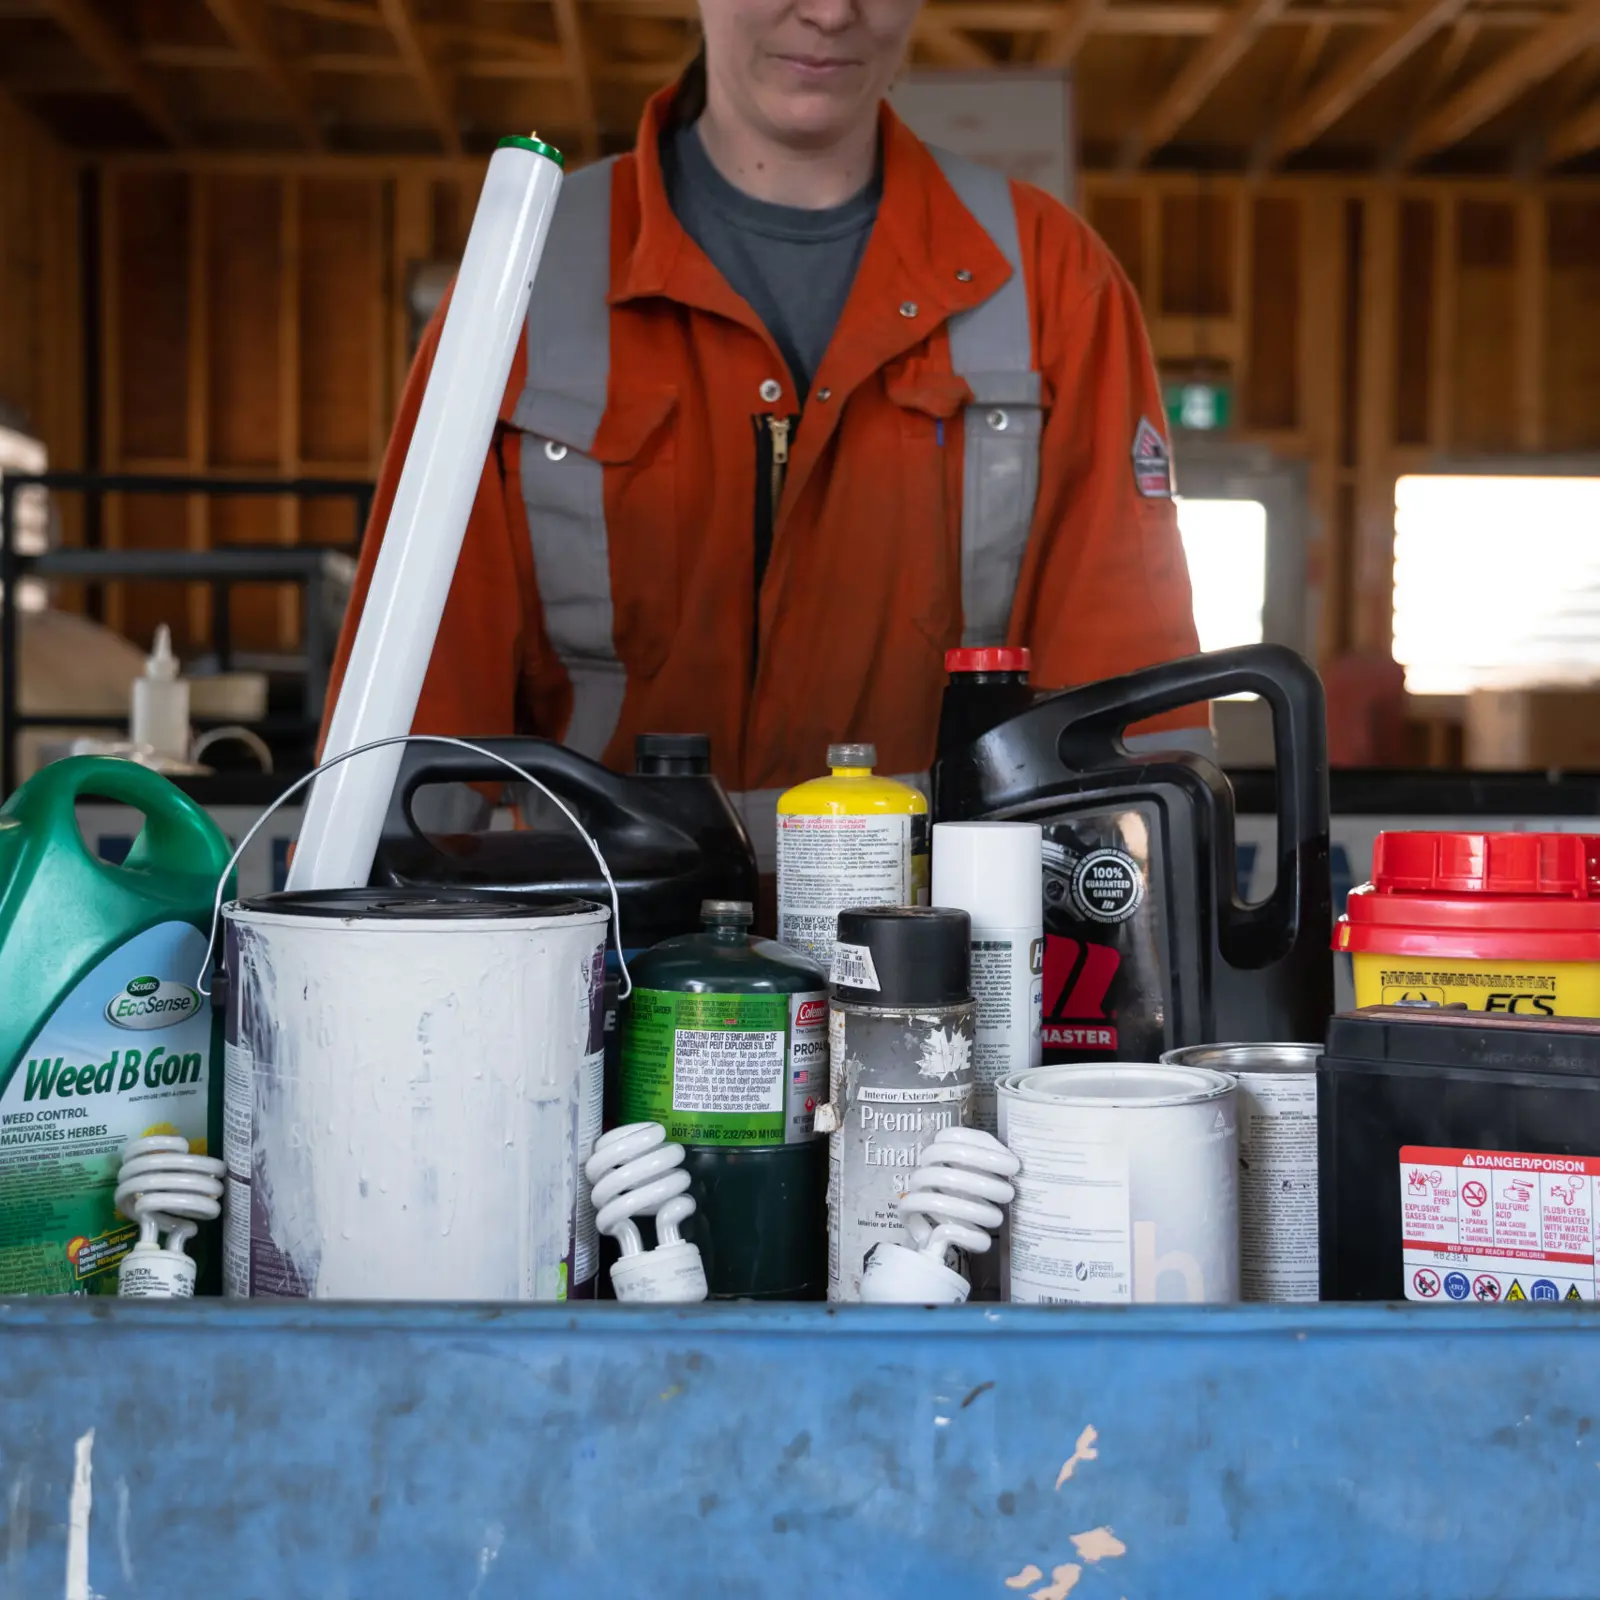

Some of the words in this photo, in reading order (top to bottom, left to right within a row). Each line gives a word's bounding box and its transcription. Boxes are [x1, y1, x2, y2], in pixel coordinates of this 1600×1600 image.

[1092, 866, 1123, 879] 100%
[1085, 880, 1130, 888] GUARANTEED
[1092, 890, 1124, 898] GARANTI
[130, 981, 158, 992] Scotts
[116, 996, 190, 1017] EcoSense
[676, 1030, 684, 1039] LE
[684, 1031, 709, 1040] CONTENU
[710, 1032, 724, 1040] PEUT
[726, 1032, 765, 1041] S'ENFLAMMER
[770, 1032, 777, 1041] CE
[676, 1040, 708, 1049] CONTENANT
[710, 1041, 724, 1049] PEUT
[724, 1042, 753, 1050] EXPLOSER
[754, 1042, 764, 1050] S'IL
[765, 1042, 774, 1050] EST
[24, 1050, 120, 1101] Weed
[119, 1049, 142, 1091] B
[144, 1046, 202, 1088] Gon
[864, 1090, 938, 1100] Interior/Exterior
[2, 1112, 34, 1125] WEED
[36, 1108, 88, 1122] CONTROL
[861, 1105, 952, 1132] Premim
[1, 1125, 44, 1134] SUPPRESSION
[703, 1128, 721, 1138] NRC
[723, 1130, 757, 1139] 232/290
[0, 1129, 65, 1146] MAUVAISES
[68, 1124, 108, 1139] HERBES
[66, 1148, 94, 1158] HERBICIDE
[864, 1135, 922, 1168] Émail
[1476, 1155, 1585, 1172] DANGER/POISON
[1433, 1189, 1457, 1197] SHIELD
[1404, 1203, 1440, 1212] EXPLOSIVE
[1495, 1202, 1529, 1212] SULFURIC
[1543, 1206, 1566, 1214] FLUSH
[1568, 1208, 1586, 1216] EYES
[1405, 1212, 1426, 1220] GASES
[1472, 1209, 1481, 1217] NO
[1495, 1211, 1512, 1219] ACID
[858, 1218, 879, 1227] Interior
[1544, 1215, 1590, 1225] IMMEDIATELY
[1544, 1224, 1562, 1232] WITH
[1560, 1233, 1590, 1243] MEDICAL
[1544, 1240, 1562, 1249] HELP
[1485, 1248, 1504, 1256] REACH
[1506, 1249, 1513, 1257] OF
[1516, 1250, 1546, 1259] CHILDREN
